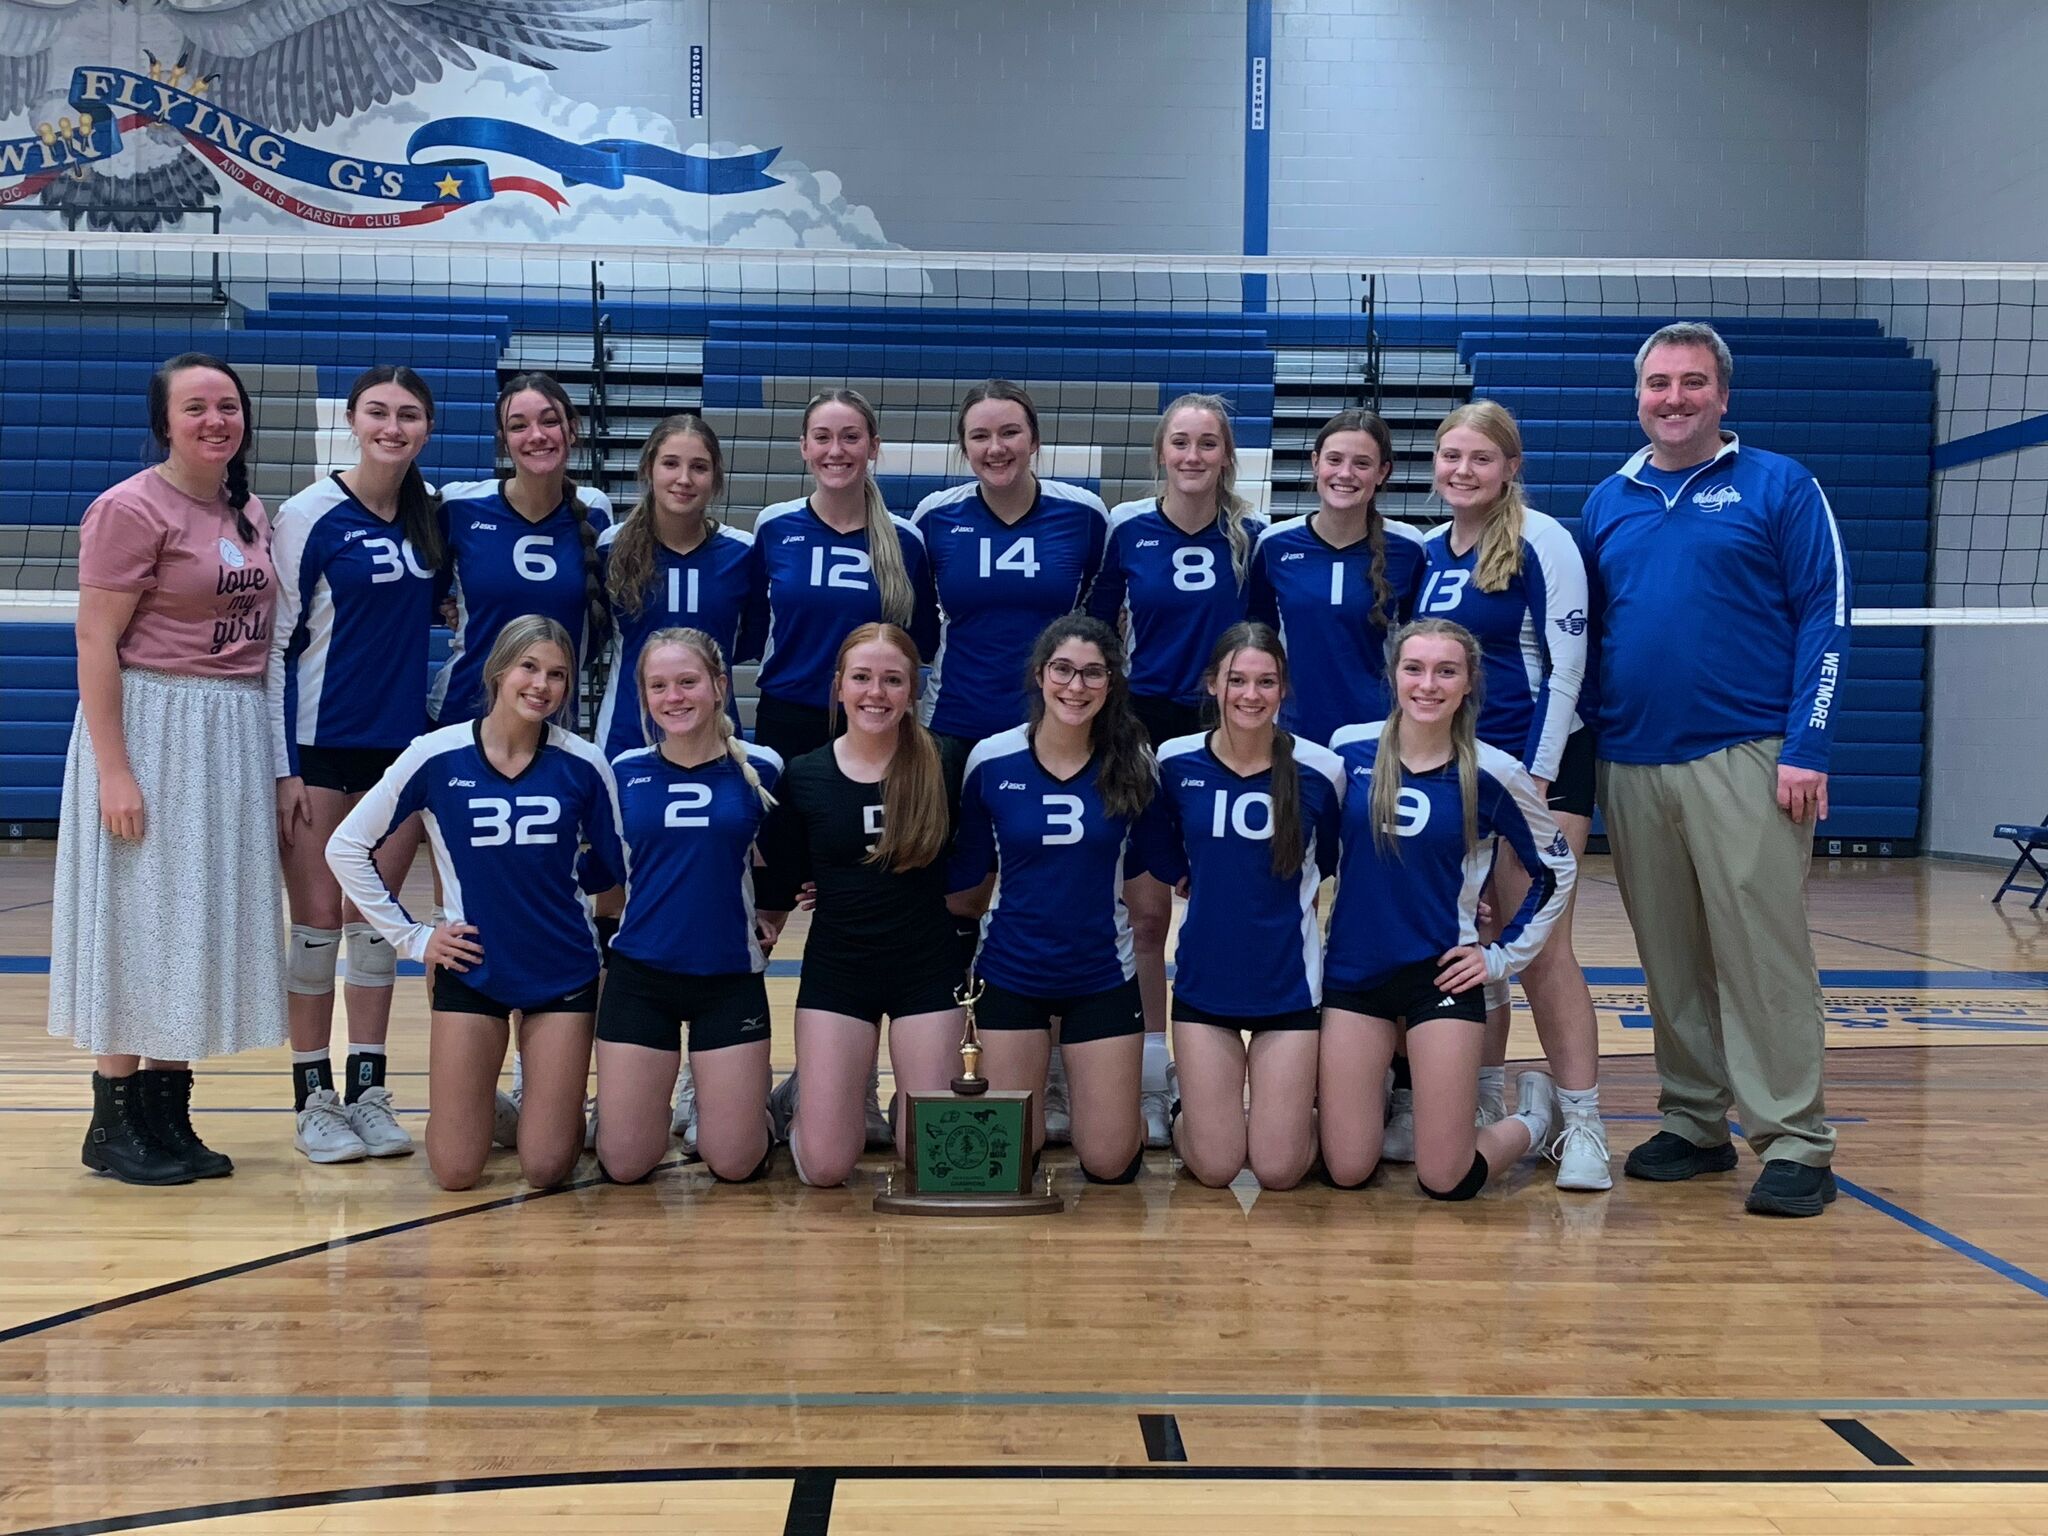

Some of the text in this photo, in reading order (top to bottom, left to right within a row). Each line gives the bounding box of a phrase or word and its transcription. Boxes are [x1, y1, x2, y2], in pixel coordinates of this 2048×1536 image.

[691, 47, 701, 115] SOPHOMORES
[1254, 59, 1263, 127] FRESHMEN
[80, 70, 287, 170] FLYING
[0, 187, 22, 203] OC
[218, 159, 246, 182] AND
[296, 204, 356, 227] VARSITY
[365, 214, 401, 227] CLUB
[216, 565, 269, 596] love
[512, 534, 558, 582] 6
[809, 546, 873, 591] 12
[979, 536, 1041, 578] 14
[1171, 546, 1217, 592] 8
[227, 594, 256, 617] my
[668, 567, 699, 613] 11
[1330, 561, 1345, 605] 1
[1418, 568, 1471, 613] 13
[210, 611, 268, 655] girls
[1808, 652, 1840, 730] WETMORE
[468, 796, 562, 847] 32
[664, 782, 713, 828] 2
[1041, 794, 1085, 845] 3
[1211, 789, 1275, 840] 10
[1381, 786, 1432, 837] 9
